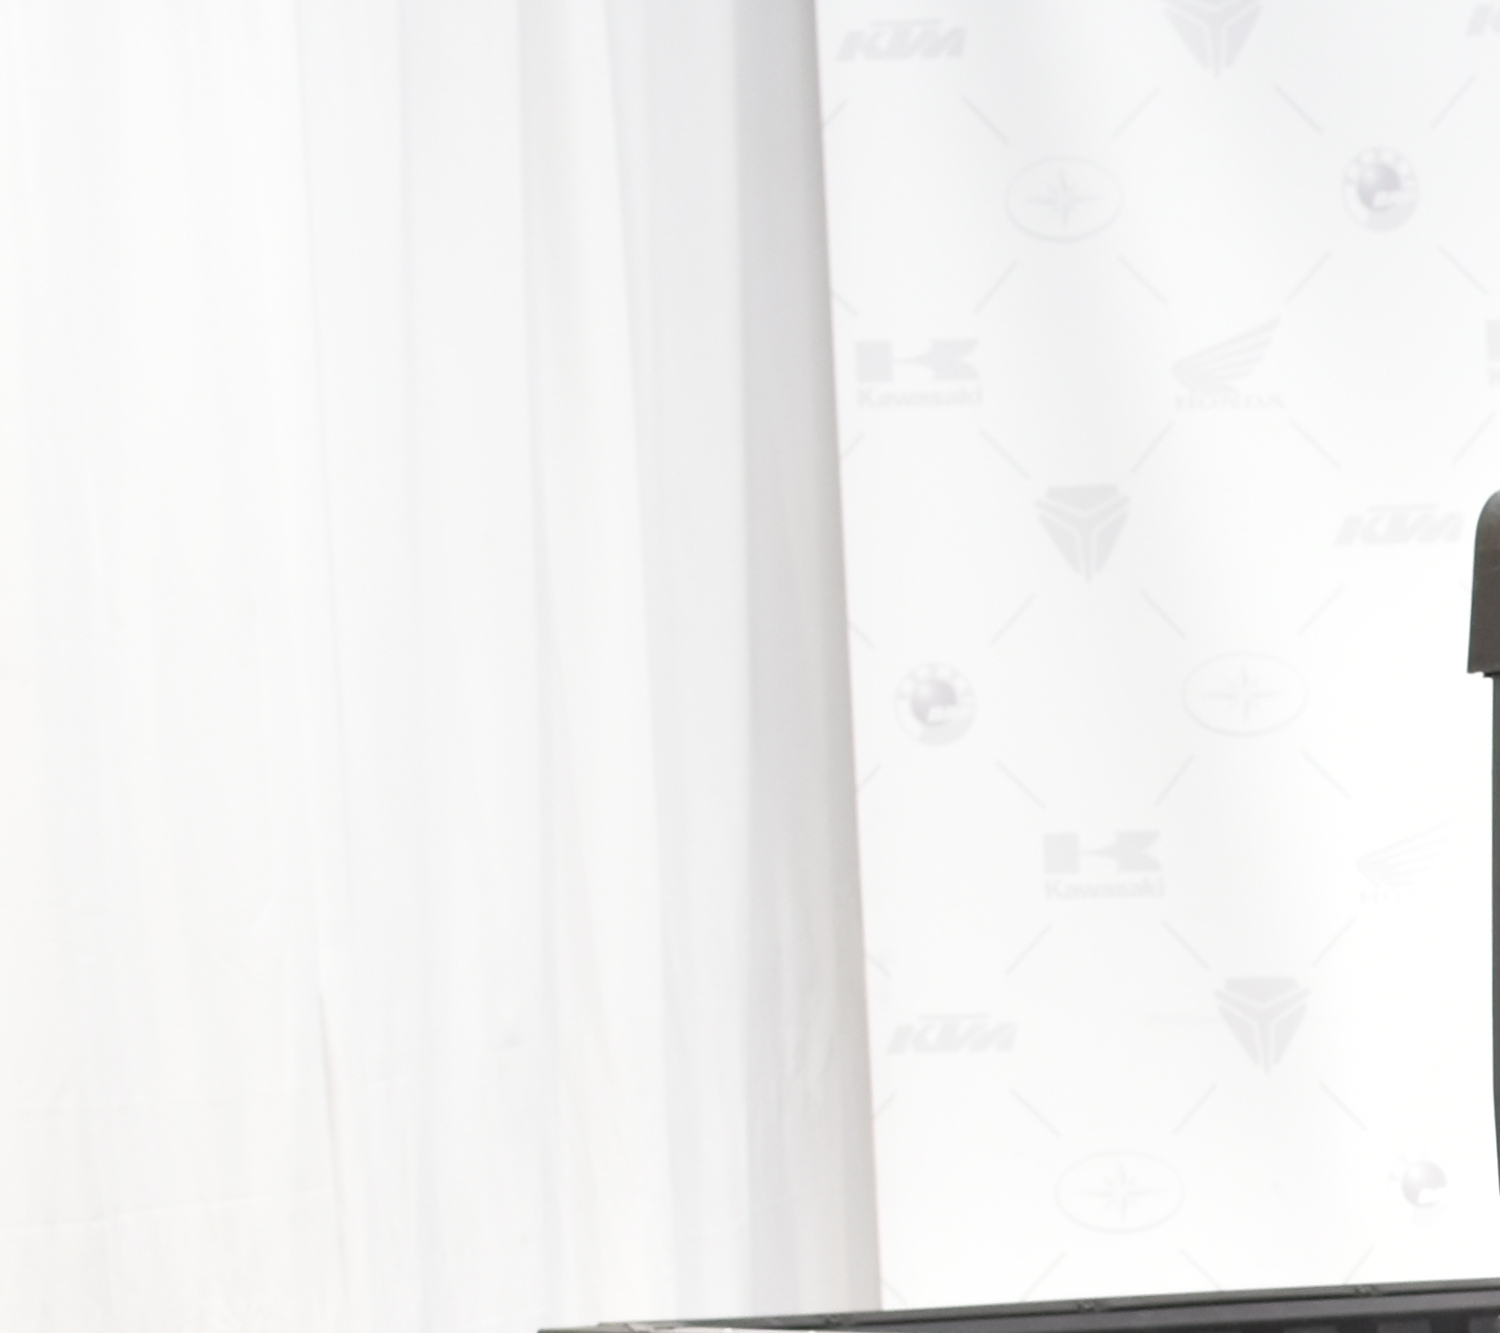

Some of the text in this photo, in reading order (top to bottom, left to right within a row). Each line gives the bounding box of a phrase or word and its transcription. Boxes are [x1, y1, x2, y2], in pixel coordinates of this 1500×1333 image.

[837, 19, 967, 61] KTM
[1334, 503, 1462, 546] KTM
[887, 1014, 1017, 1055] KTM
